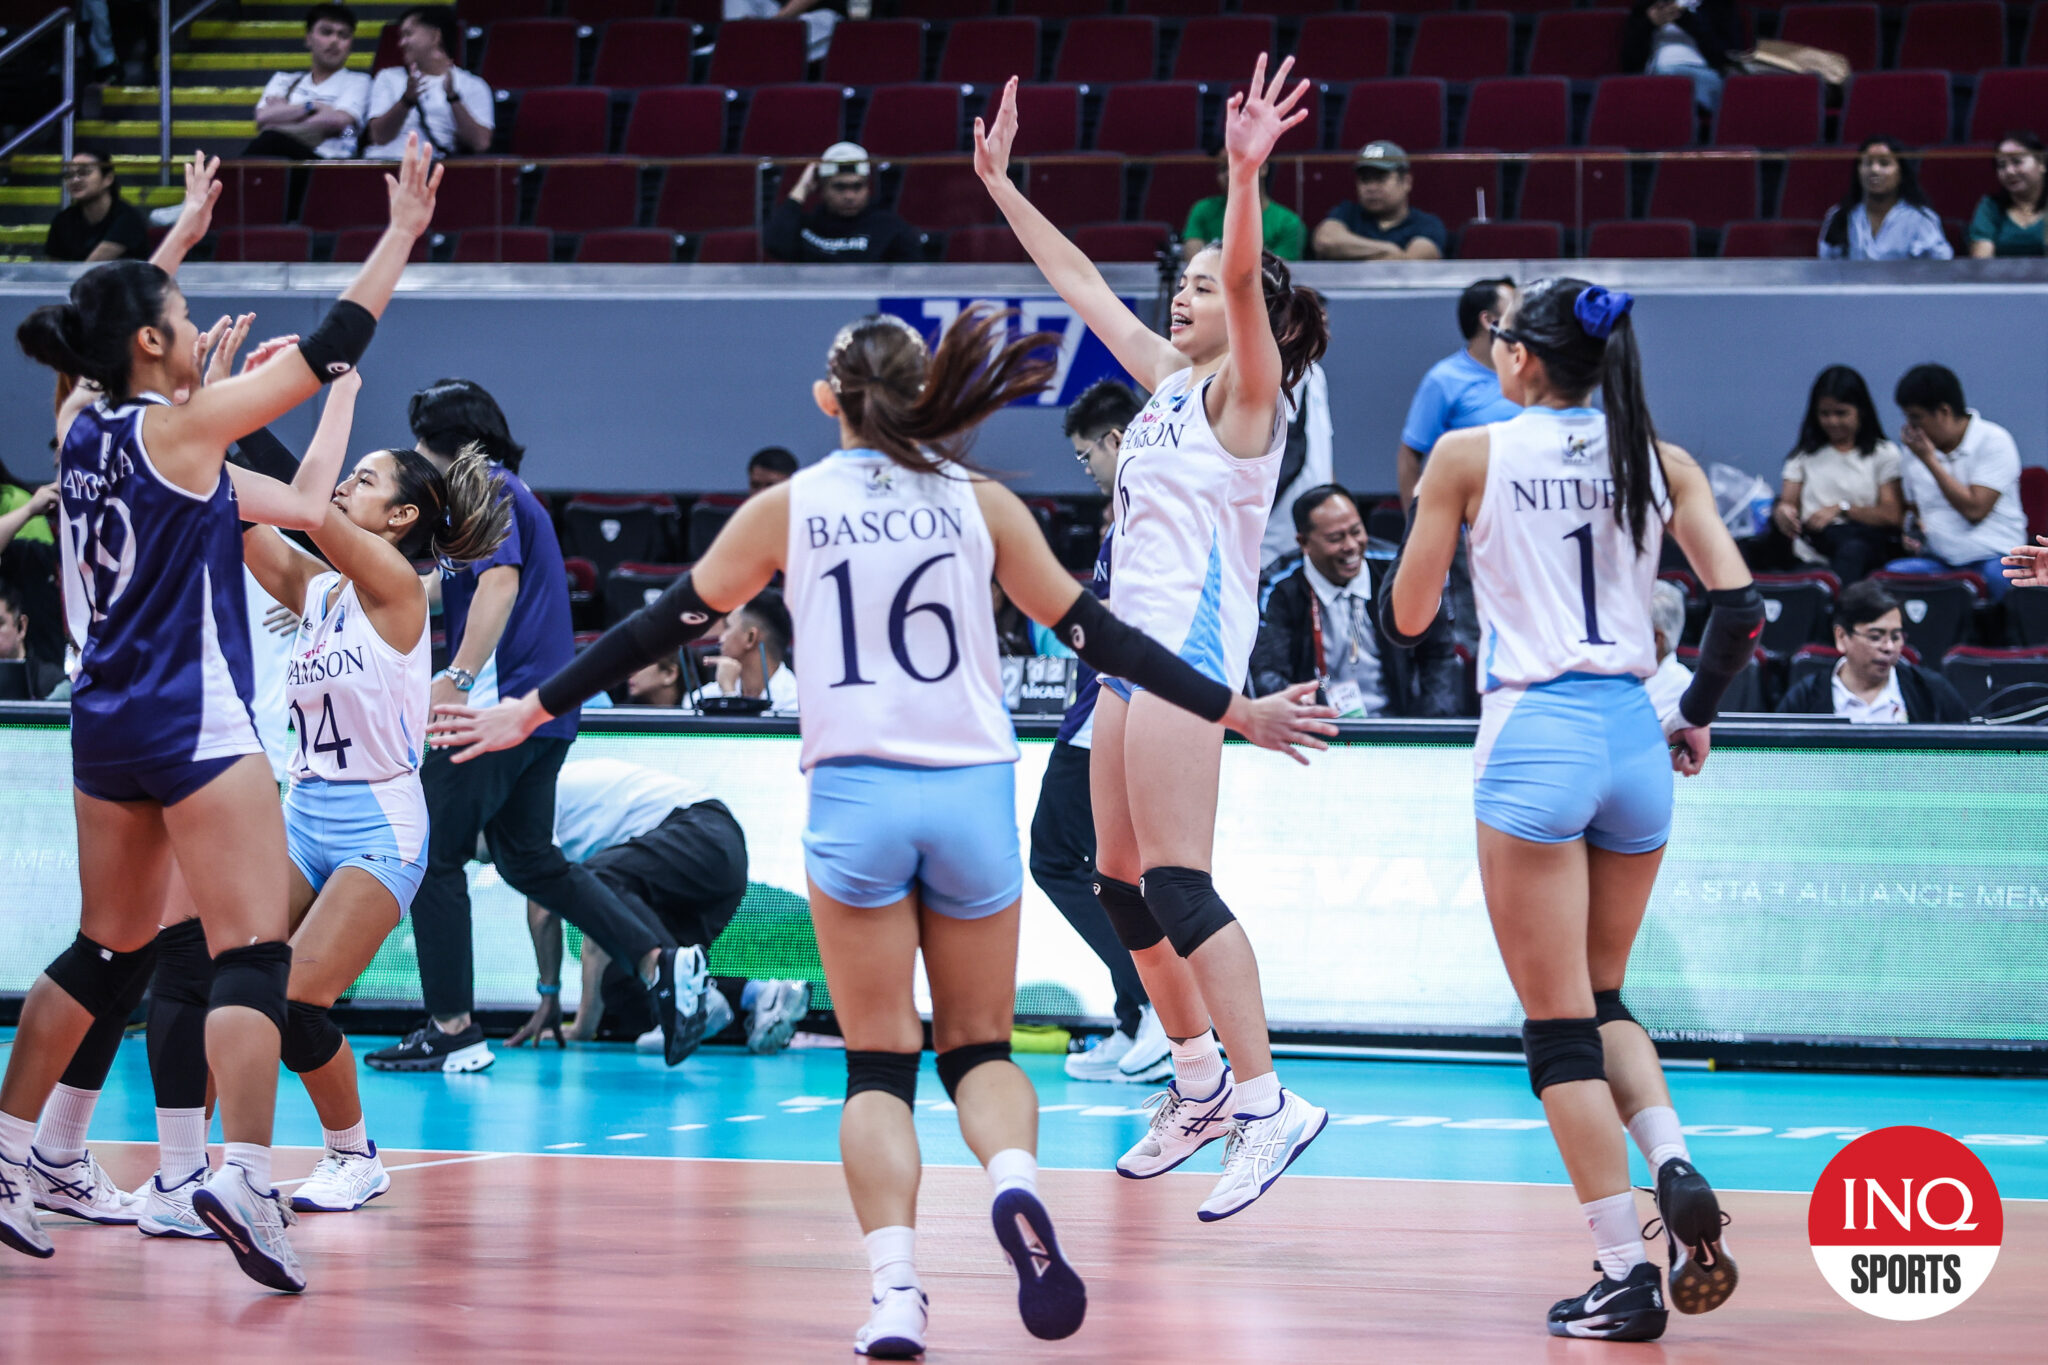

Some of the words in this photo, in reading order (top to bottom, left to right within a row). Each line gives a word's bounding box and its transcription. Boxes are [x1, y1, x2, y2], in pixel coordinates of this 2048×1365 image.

[1121, 422, 1186, 450] AMSON
[1510, 478, 1617, 512] NITUR
[807, 507, 962, 549] BASCON
[70, 498, 137, 623] 19
[1562, 522, 1617, 645] 1
[820, 552, 960, 688] 16
[288, 645, 365, 685] AMSON
[289, 693, 352, 772] 14
[1800, 882, 1965, 908] ALLIANCE
